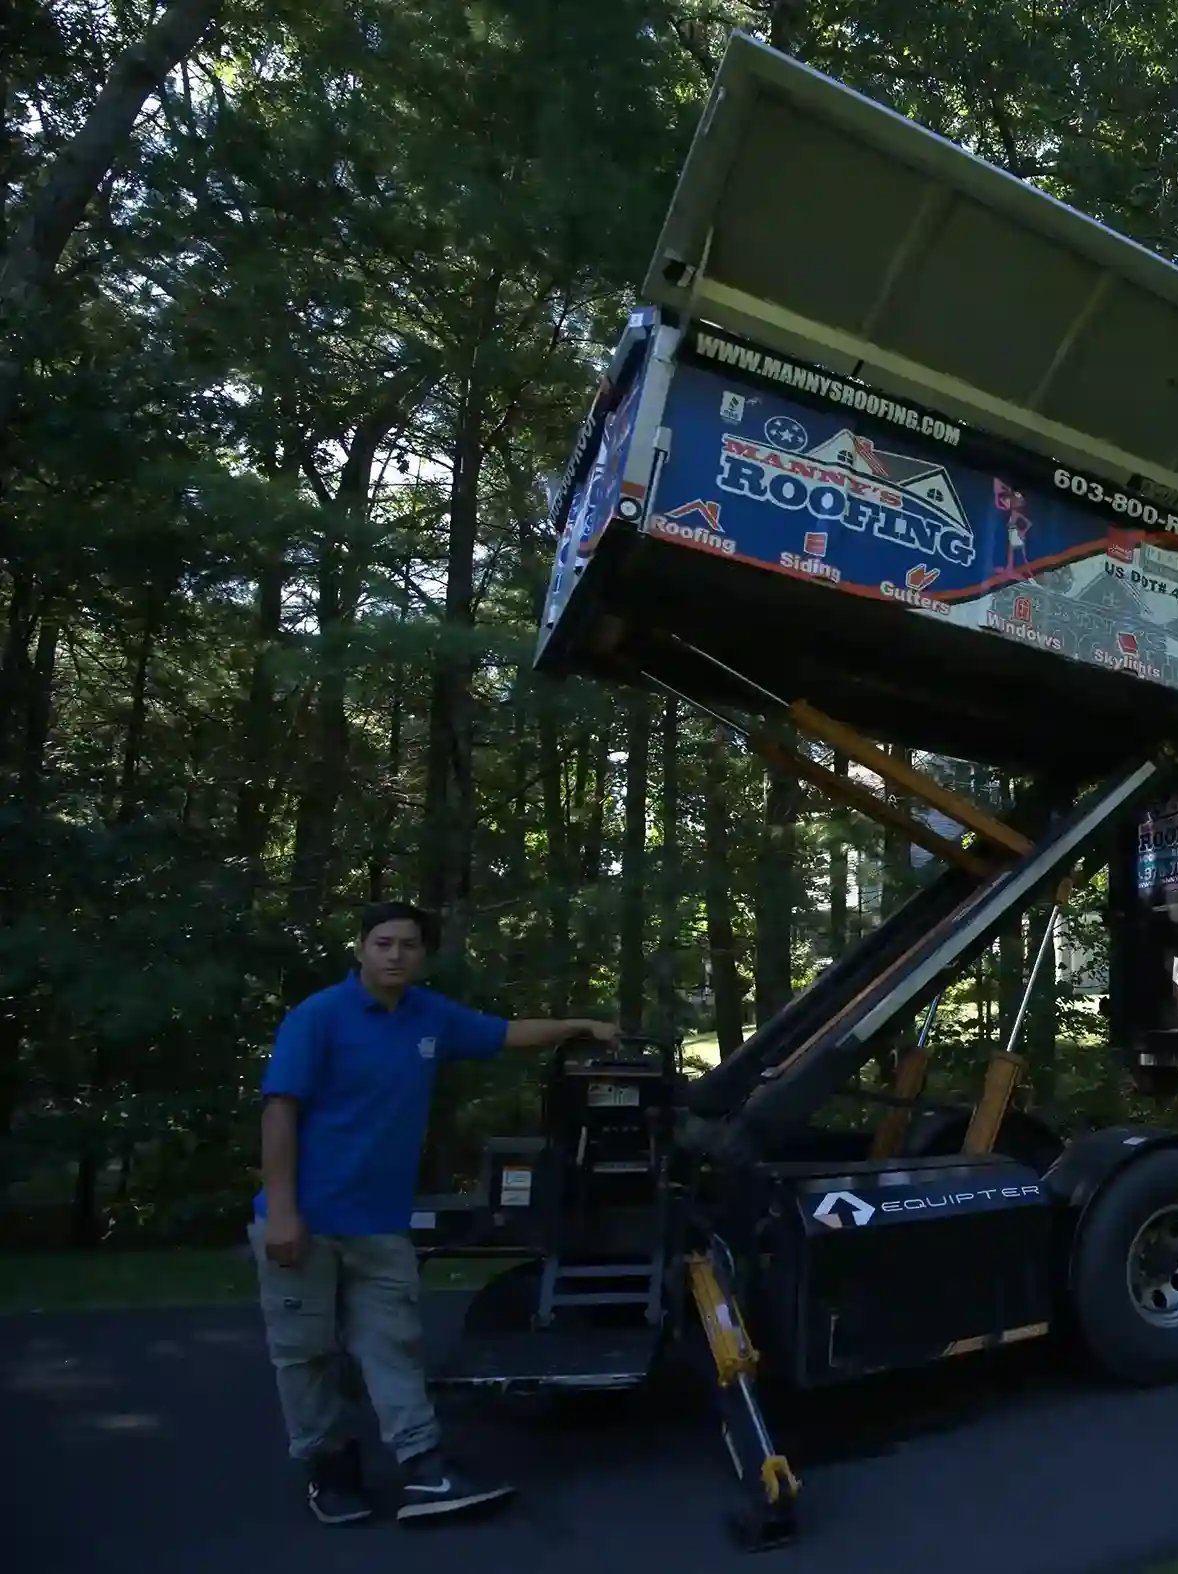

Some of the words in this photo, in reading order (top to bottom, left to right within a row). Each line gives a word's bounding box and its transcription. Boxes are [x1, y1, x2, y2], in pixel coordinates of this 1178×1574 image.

[696, 332, 961, 447] WWW.MANNYSROOFING.COM
[723, 438, 903, 507] MANNY'S
[716, 453, 976, 567] ROOFING
[652, 514, 736, 556] Roofing
[779, 550, 841, 584] Siding
[1104, 561, 1125, 580] US
[1131, 569, 1167, 594] DOT#
[880, 580, 950, 616] Gutters
[986, 610, 1062, 651] Windows
[1094, 648, 1161, 681] Skylights
[881, 1183, 1040, 1213] EQUIPTER
